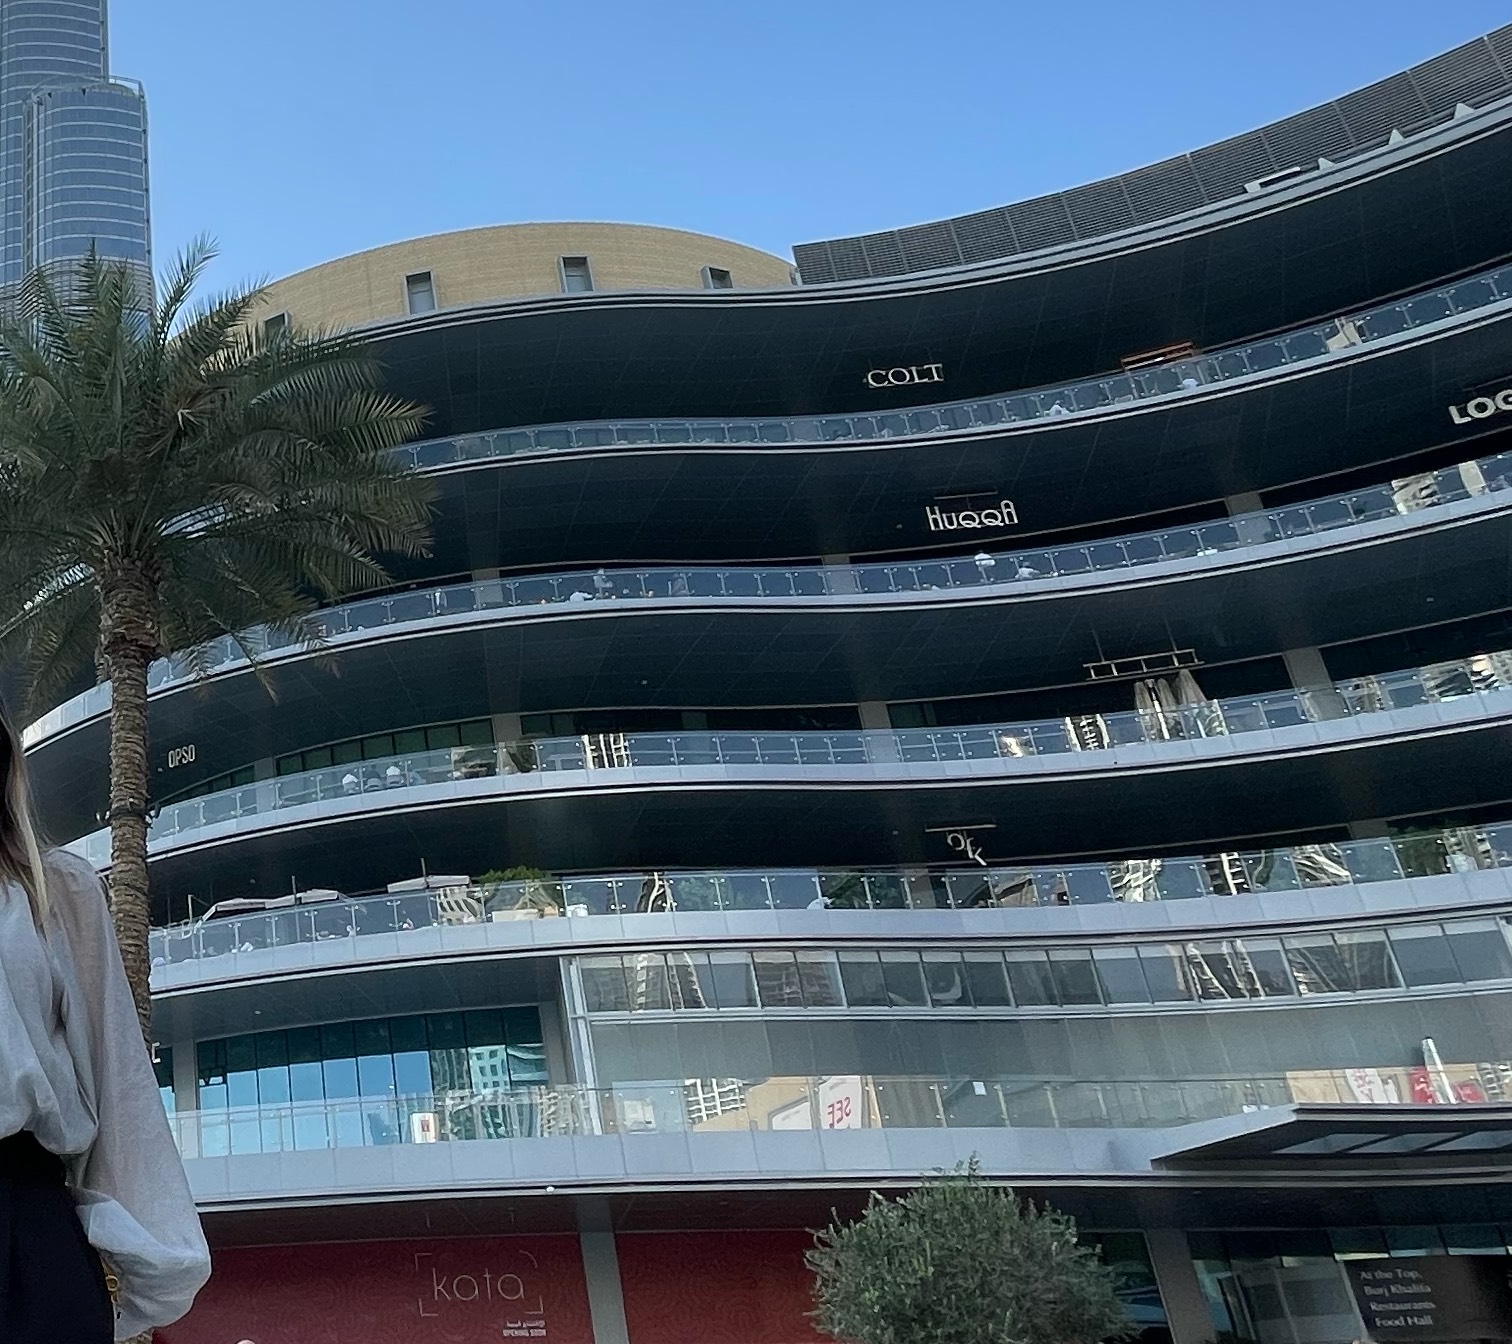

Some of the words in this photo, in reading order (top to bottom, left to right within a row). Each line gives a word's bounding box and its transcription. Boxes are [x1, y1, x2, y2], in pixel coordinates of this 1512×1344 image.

[867, 363, 944, 388] COLT
[168, 744, 196, 768] OPSO
[432, 1267, 525, 1301] kata
[1390, 1283, 1432, 1294] Khalifa
[1370, 1301, 1437, 1311] Restaurants
[1375, 1317, 1406, 1327] Food
[1407, 1315, 1434, 1326] Hall
